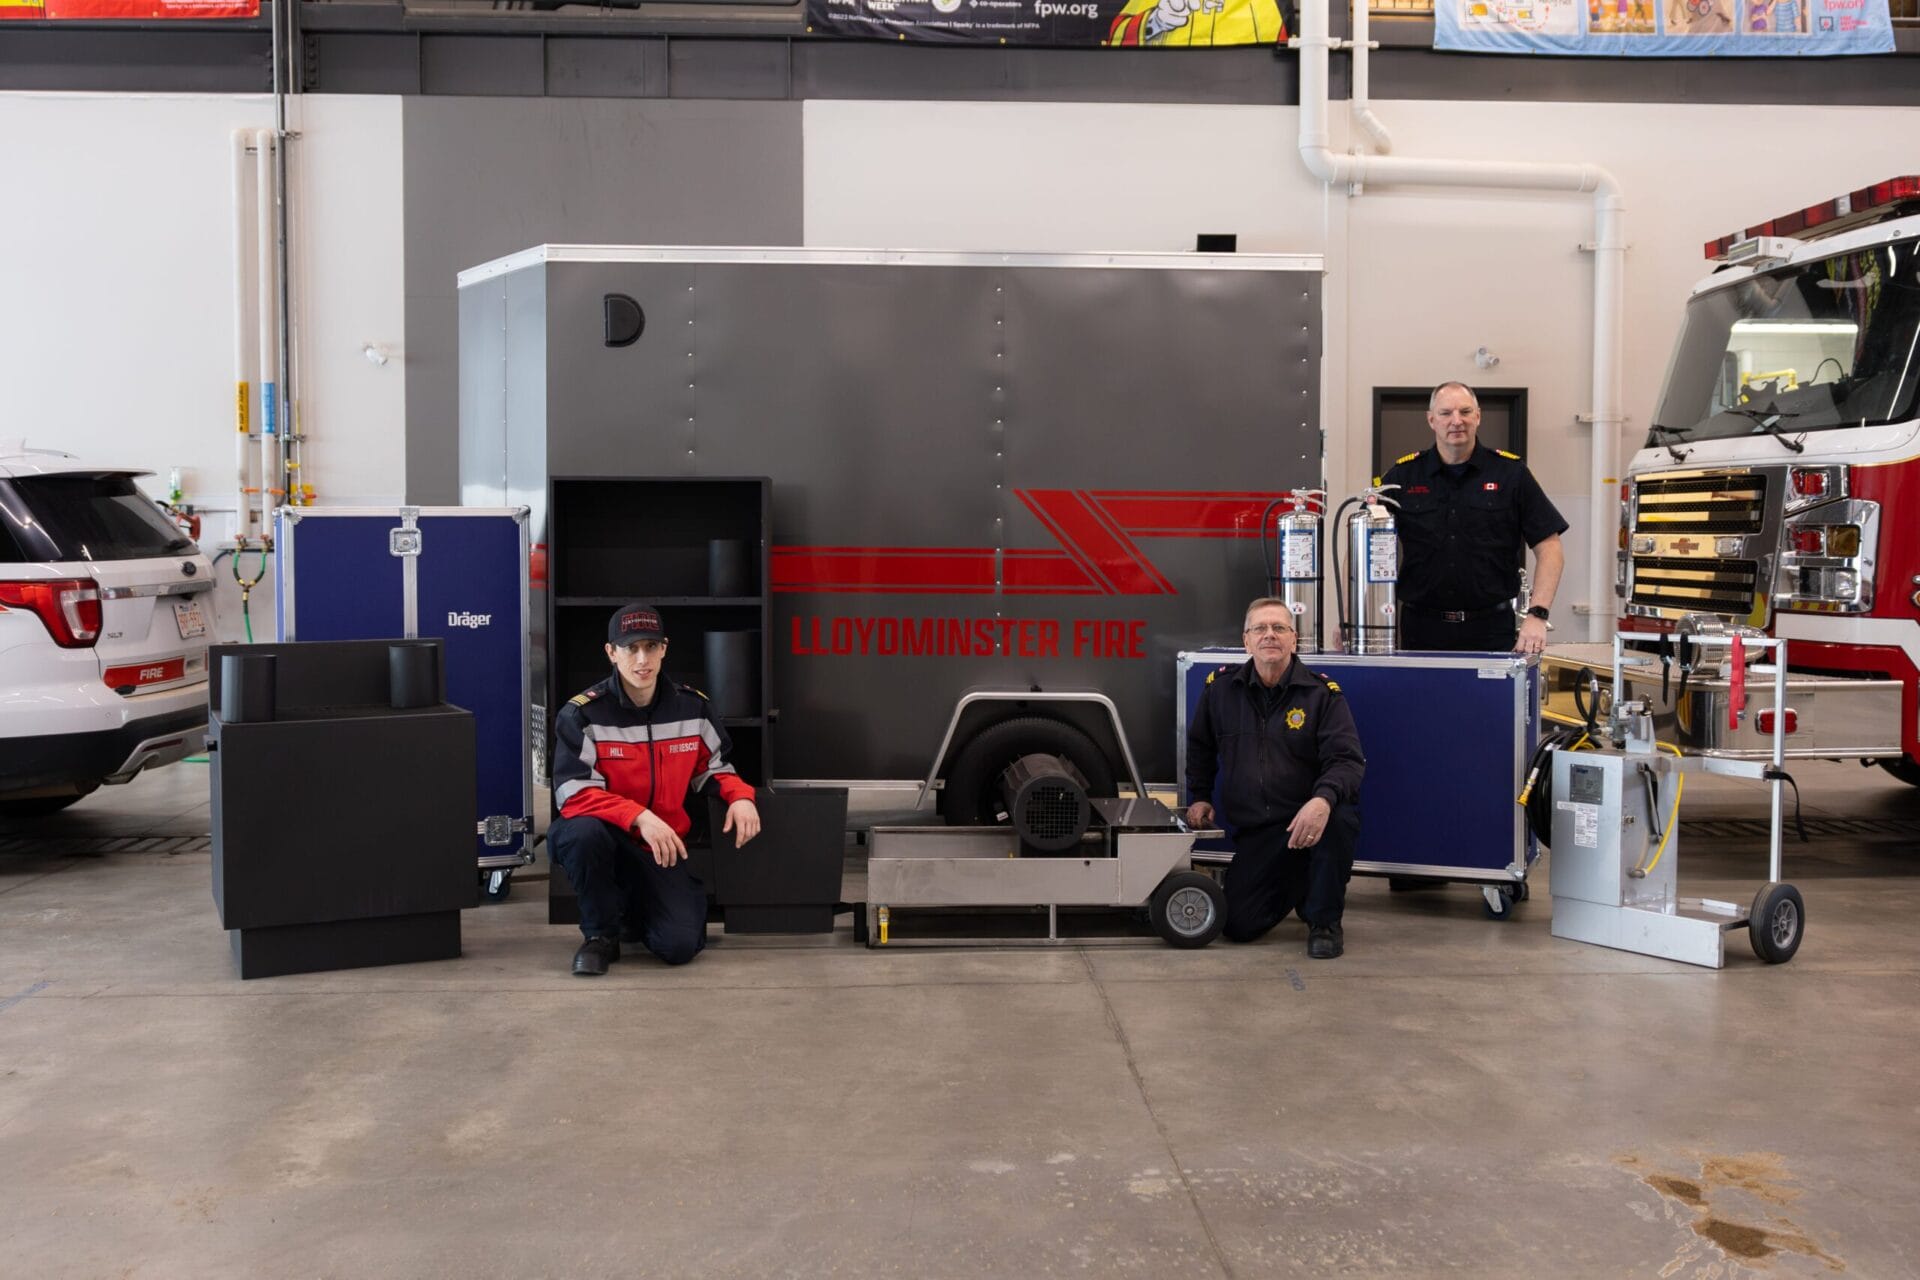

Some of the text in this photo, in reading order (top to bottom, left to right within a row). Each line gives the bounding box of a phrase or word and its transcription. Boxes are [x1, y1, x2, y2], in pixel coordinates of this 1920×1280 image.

[1034, 0, 1098, 19] fpw.org
[448, 611, 492, 629] Dräger
[791, 616, 1147, 658] LLOYDMINSTER FIRE
[140, 666, 164, 680] FIRE
[610, 747, 624, 757] HILL
